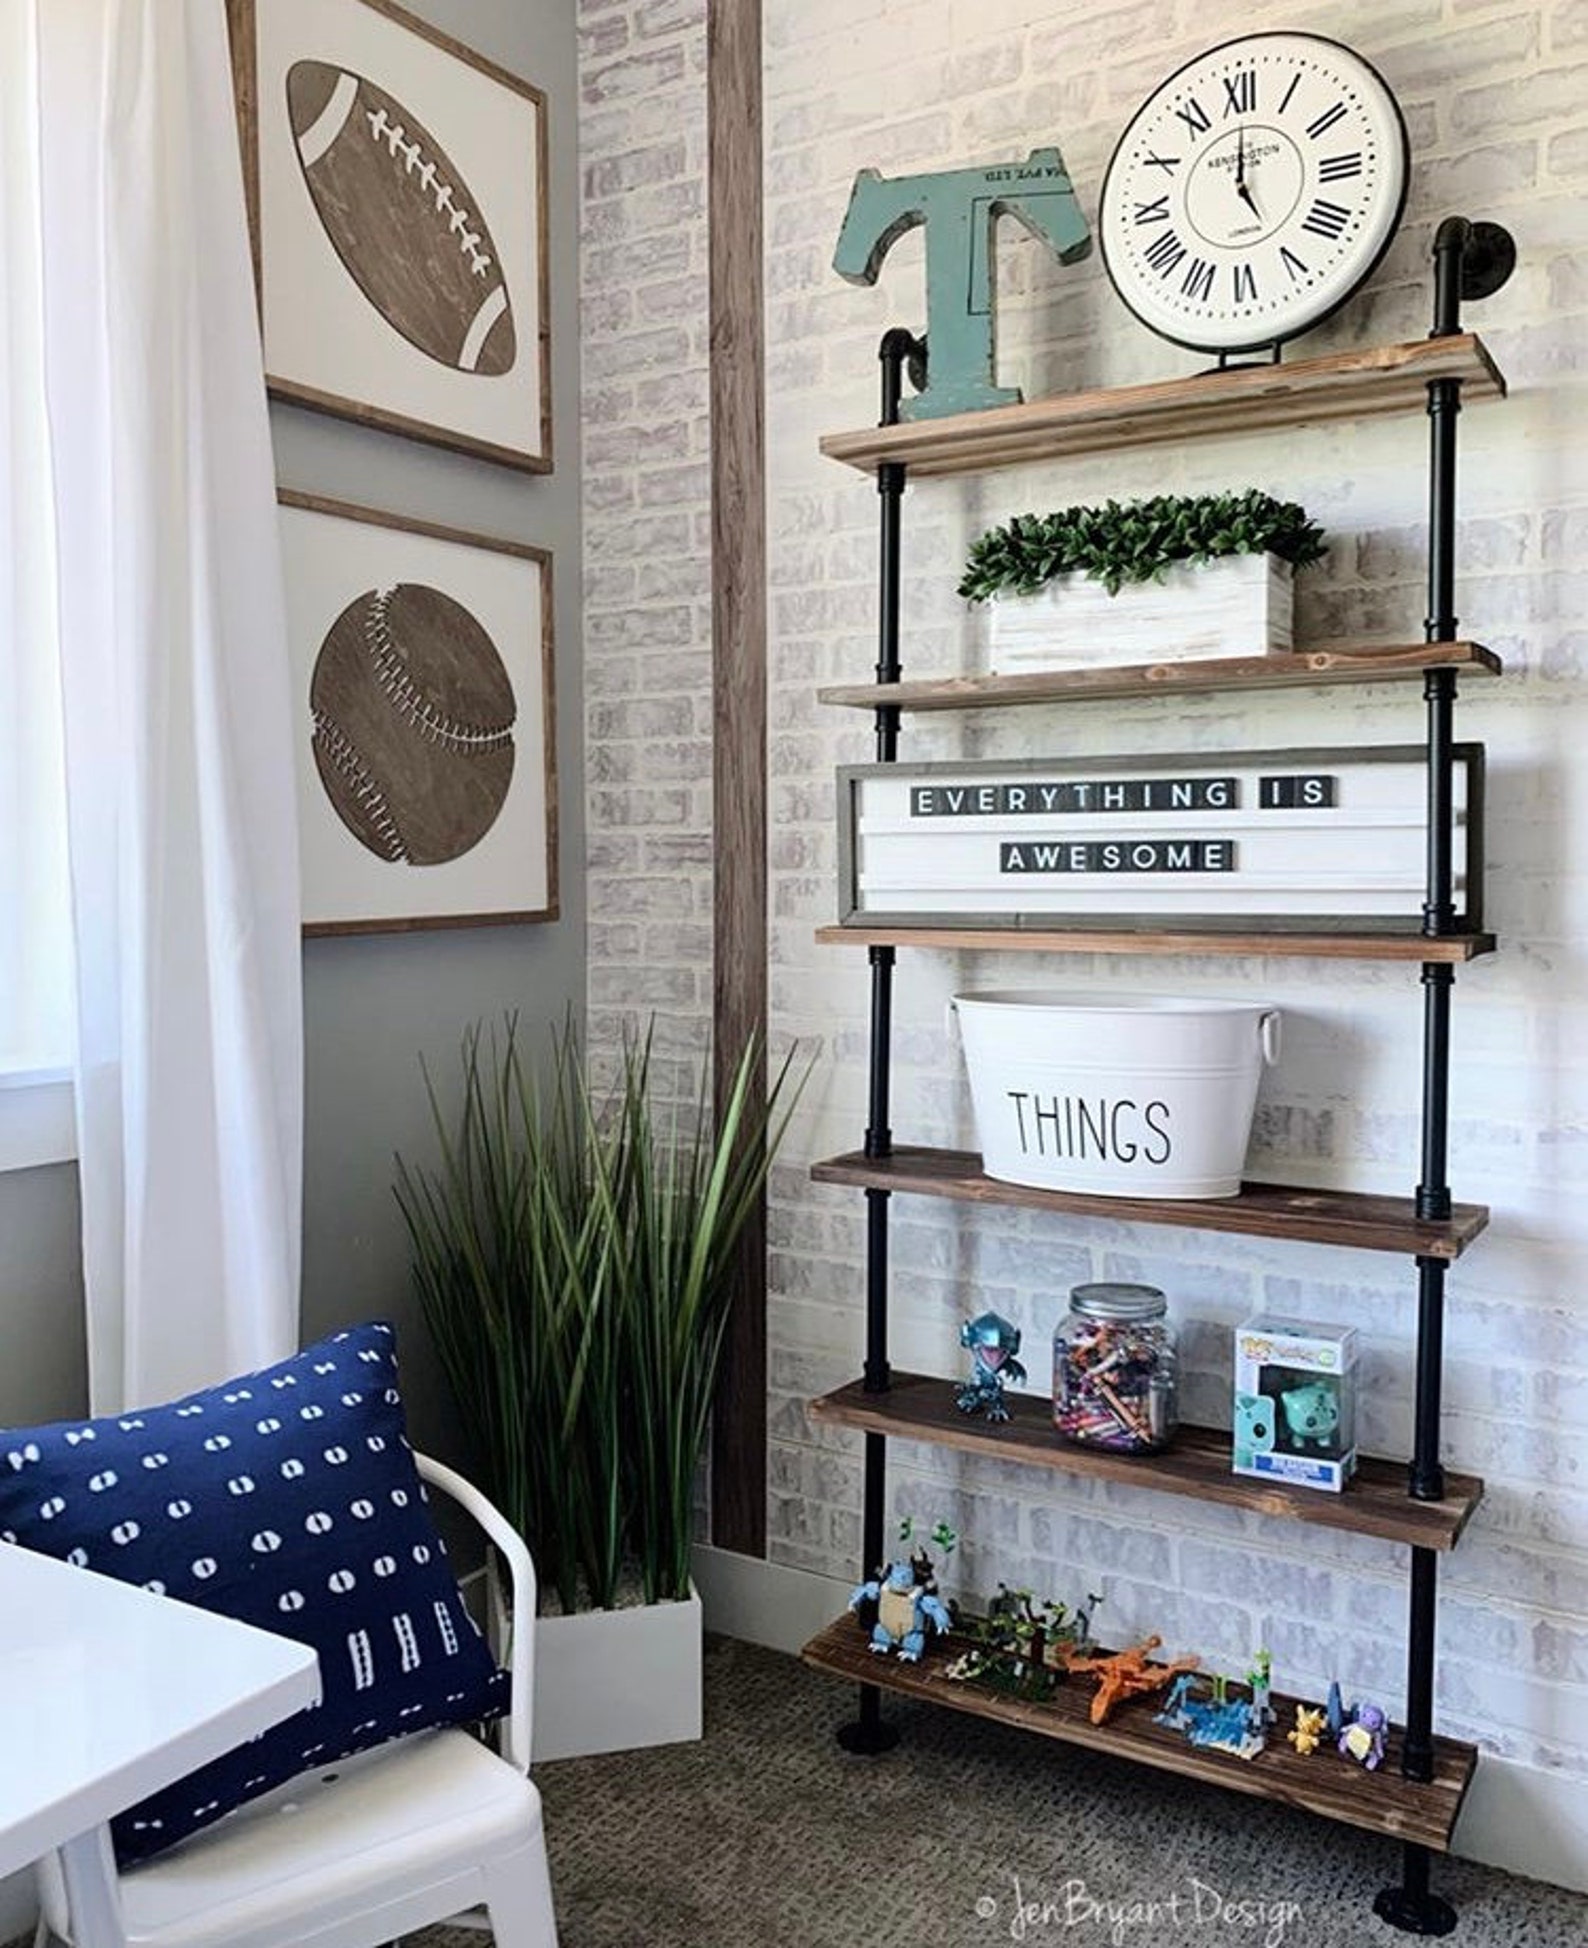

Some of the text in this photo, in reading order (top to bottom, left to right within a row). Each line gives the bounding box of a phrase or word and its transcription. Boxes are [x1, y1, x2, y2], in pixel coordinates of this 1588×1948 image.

[1223, 70, 1255, 119] XII
[1175, 97, 1212, 142] XI
[1306, 101, 1348, 139] II
[1143, 150, 1181, 176] X
[1319, 152, 1362, 183] III
[1144, 229, 1187, 279] VIII
[1280, 247, 1308, 281] V
[1181, 258, 1216, 301] VII
[1234, 264, 1257, 302] VI
[917, 780, 1323, 813] EVERYTHING IS
[1005, 844, 1224, 870] AWESOME
[1007, 1091, 1171, 1165] THINGS
